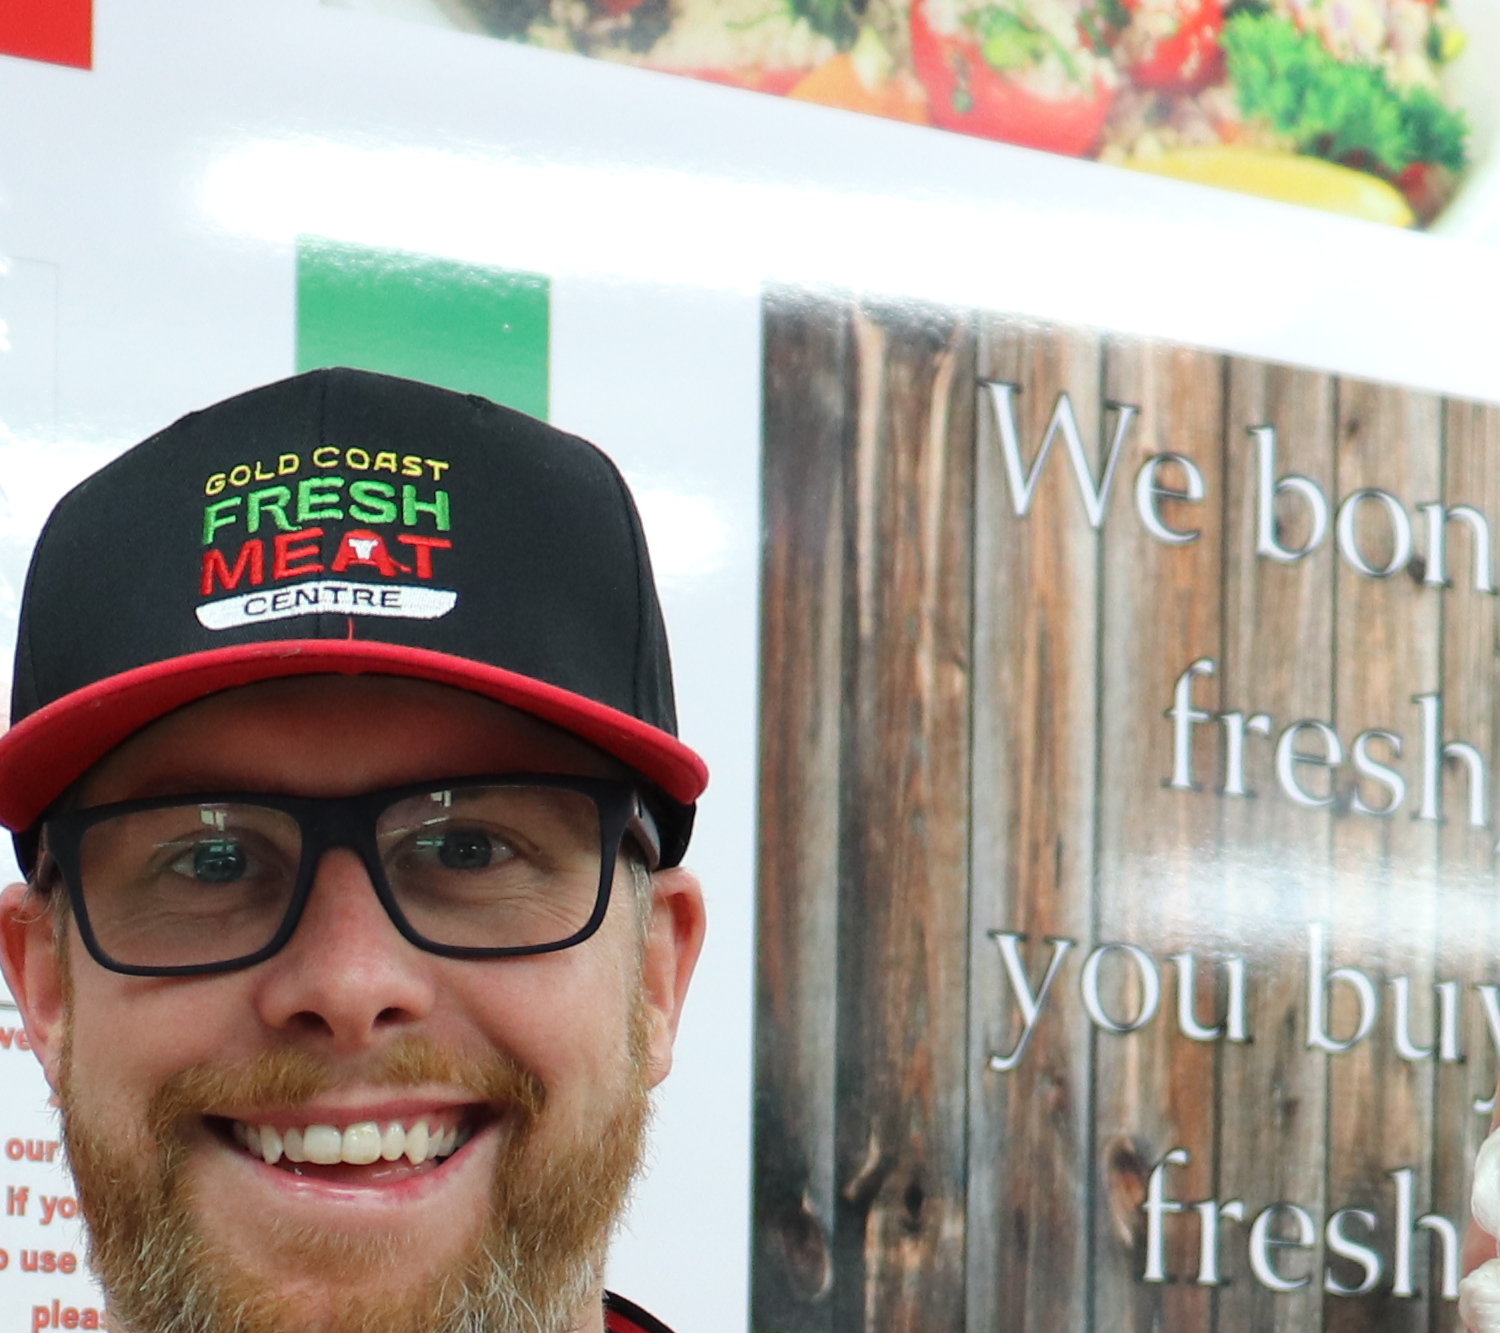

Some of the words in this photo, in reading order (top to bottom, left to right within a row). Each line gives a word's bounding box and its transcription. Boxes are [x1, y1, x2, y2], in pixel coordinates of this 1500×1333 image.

[206, 453, 300, 495] GOLD
[313, 447, 449, 481] COAST
[978, 380, 1206, 546] We
[203, 477, 450, 544] FRESH
[201, 527, 452, 596] MEAT
[244, 587, 401, 616] CENTRE
[989, 930, 1253, 1071] you
[5, 1136, 58, 1162] our
[39, 1194, 81, 1225] yo
[1141, 1148, 1461, 1301] fresh
[21, 1249, 77, 1274] use
